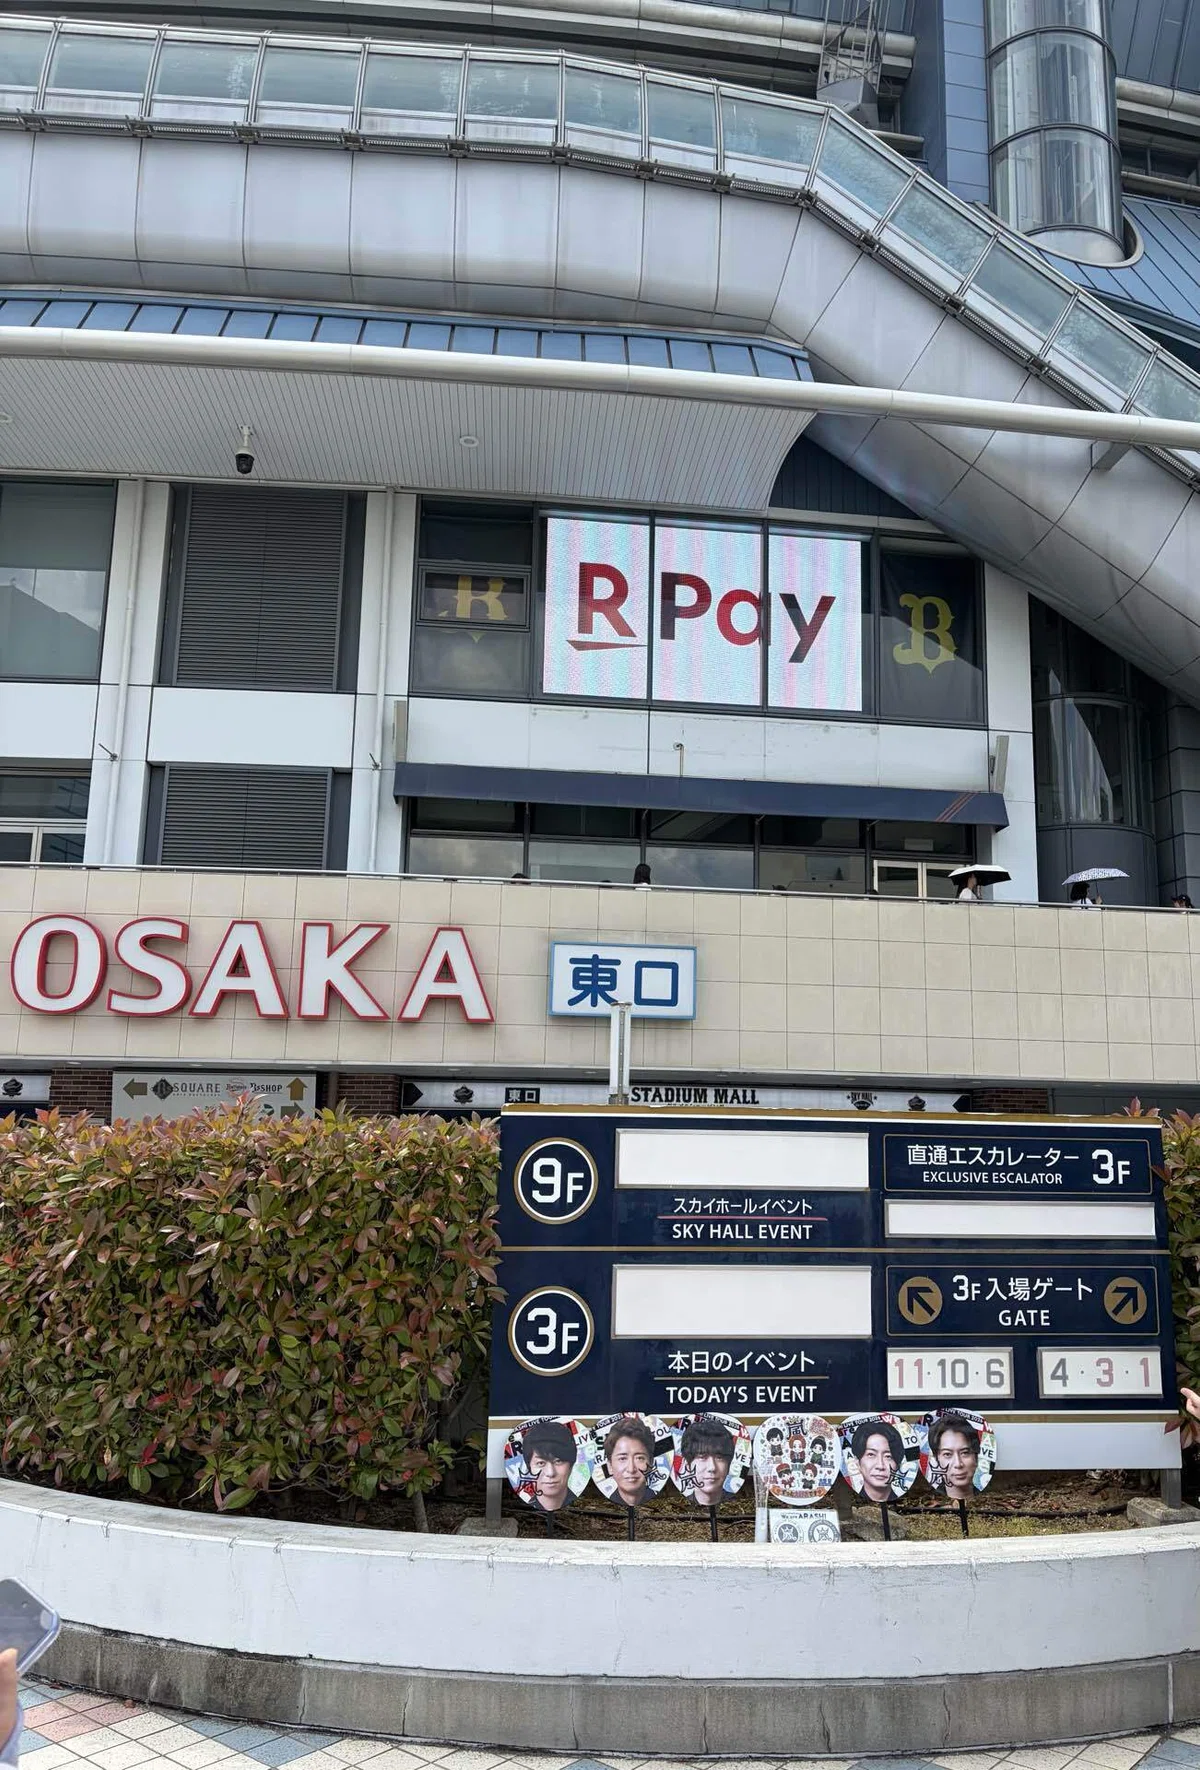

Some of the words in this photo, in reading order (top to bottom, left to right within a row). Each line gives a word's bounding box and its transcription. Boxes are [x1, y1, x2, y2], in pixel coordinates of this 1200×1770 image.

[578, 562, 637, 638] R
[660, 571, 837, 664] Pay
[893, 593, 958, 674] B
[10, 913, 495, 1024] OSAKA
[567, 954, 679, 1008] 東口
[173, 1082, 221, 1093] SQUARE
[260, 1085, 283, 1093] SHOP
[508, 1089, 539, 1103] 東口
[630, 1086, 708, 1103] STADIUM
[713, 1088, 760, 1105] MALL
[906, 1144, 1080, 1167] 直通エスカレーター
[922, 1170, 989, 1184] EXCLUSIVE
[992, 1172, 1063, 1185] ESCALATOR
[1091, 1149, 1131, 1185] 3F
[531, 1157, 585, 1204] 9F
[673, 1197, 813, 1215] スカイホールイベント
[672, 1223, 704, 1239] SKY
[709, 1223, 753, 1239] HALL
[758, 1224, 813, 1240] EVENT
[998, 1309, 1050, 1327] GATE
[526, 1307, 580, 1355] 3F
[668, 1350, 815, 1374] 本日のイベント
[665, 1386, 749, 1404] TODAY'S
[755, 1385, 818, 1403] EVENT
